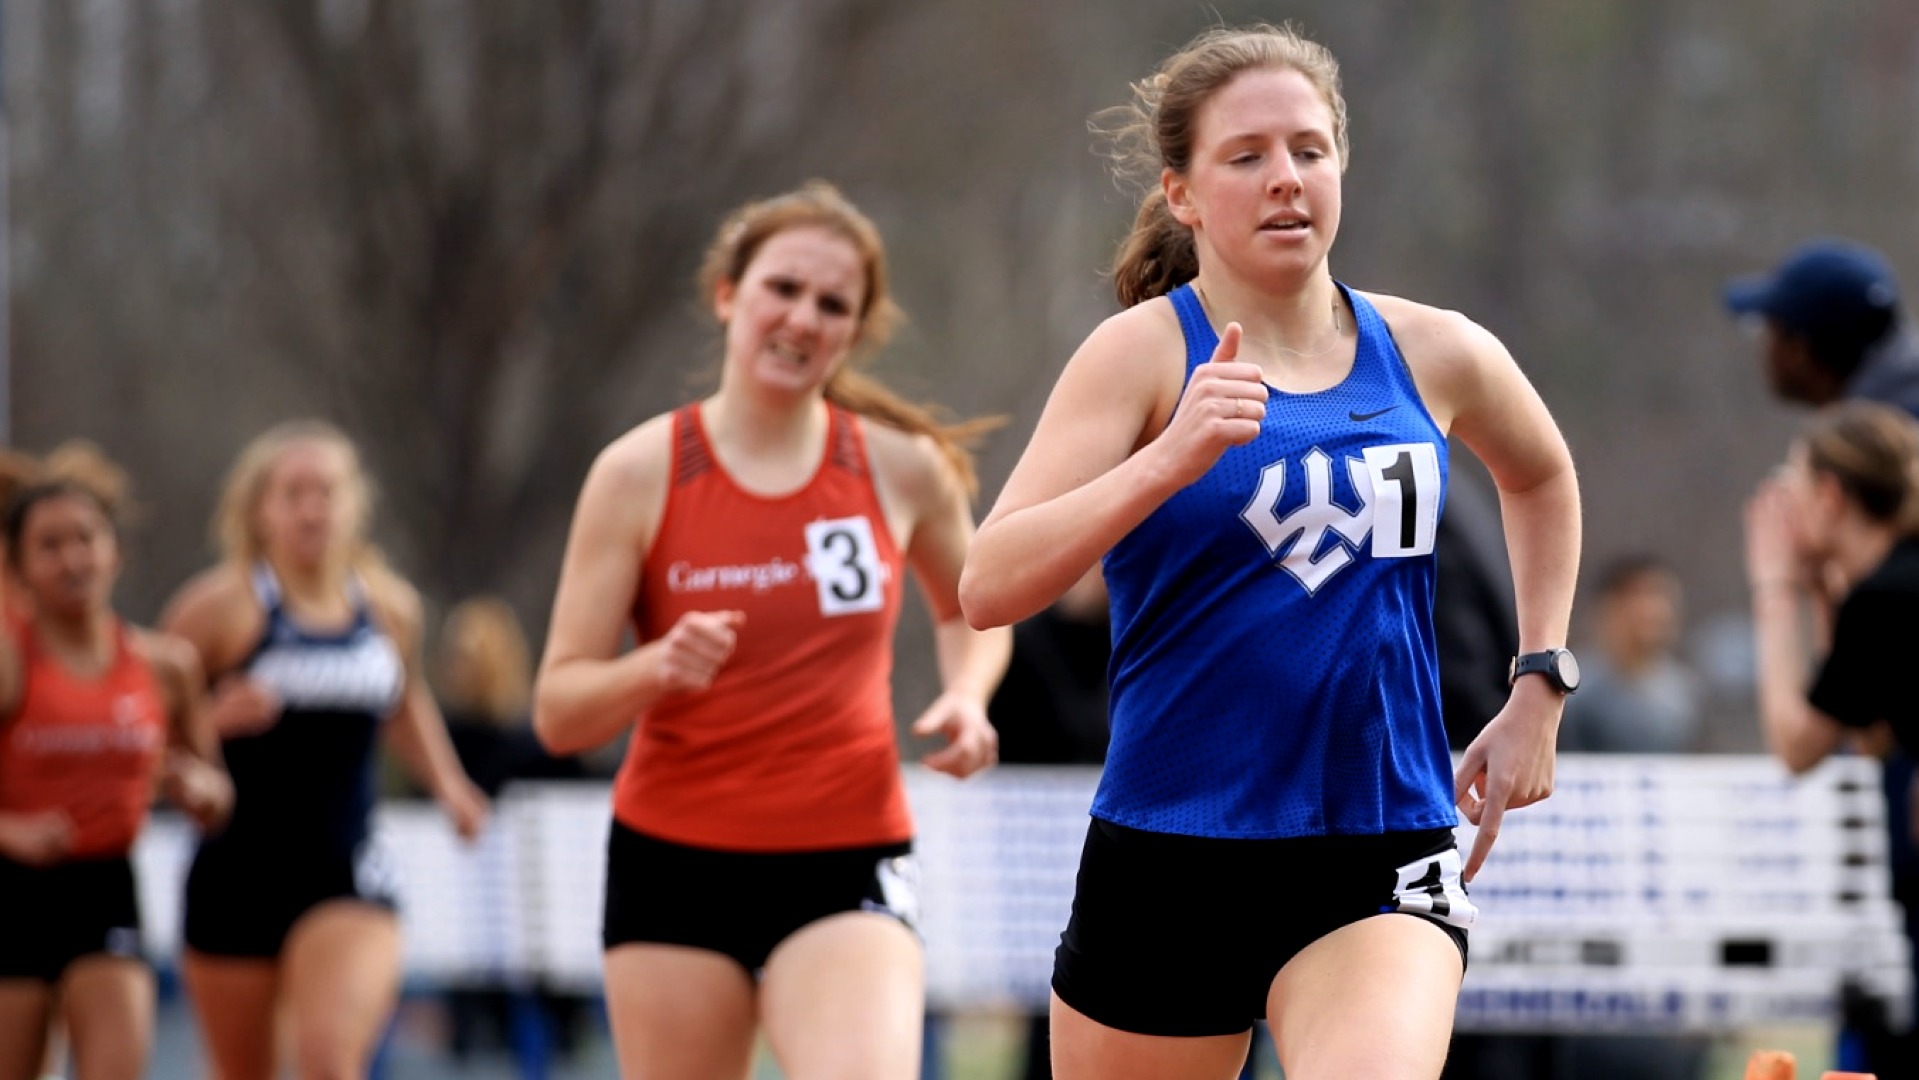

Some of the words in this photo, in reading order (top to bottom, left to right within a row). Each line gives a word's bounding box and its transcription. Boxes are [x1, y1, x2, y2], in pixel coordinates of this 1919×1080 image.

[1382, 451, 1416, 549] 1
[668, 559, 798, 592] Carnegie
[822, 529, 868, 601] 3
[1405, 861, 1450, 917] 1
